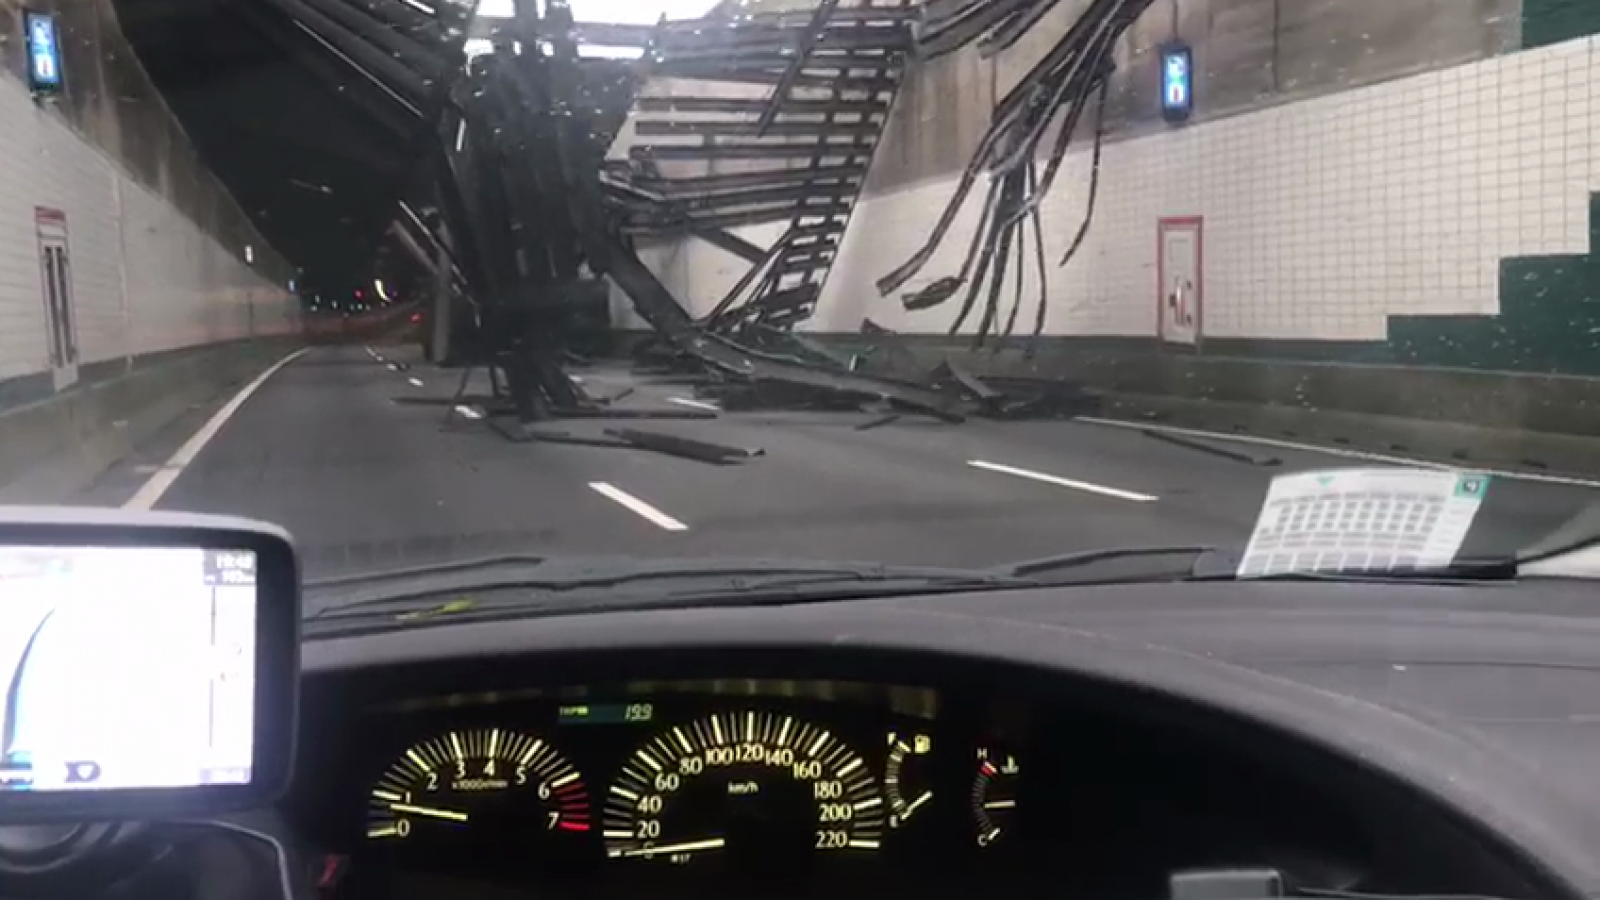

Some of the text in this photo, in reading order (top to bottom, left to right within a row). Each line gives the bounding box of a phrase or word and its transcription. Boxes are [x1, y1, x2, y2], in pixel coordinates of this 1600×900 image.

[705, 748, 733, 765] 100
[735, 743, 764, 762] 120
[765, 749, 794, 766] 140
[977, 747, 987, 759] H
[456, 760, 466, 778] 3
[484, 760, 495, 776] 4
[679, 757, 702, 775] 80
[793, 761, 822, 779] 160
[427, 772, 438, 790] 2
[516, 767, 527, 785] 5
[655, 773, 680, 791] 60
[538, 783, 550, 799] 6
[727, 781, 759, 794] km/h
[814, 780, 842, 799] 180
[637, 796, 662, 813] 40
[819, 803, 851, 821] 200
[397, 820, 410, 837] 0
[548, 812, 559, 830] 7
[637, 820, 660, 838] 20
[815, 831, 847, 849] 220
[977, 834, 987, 846] C
